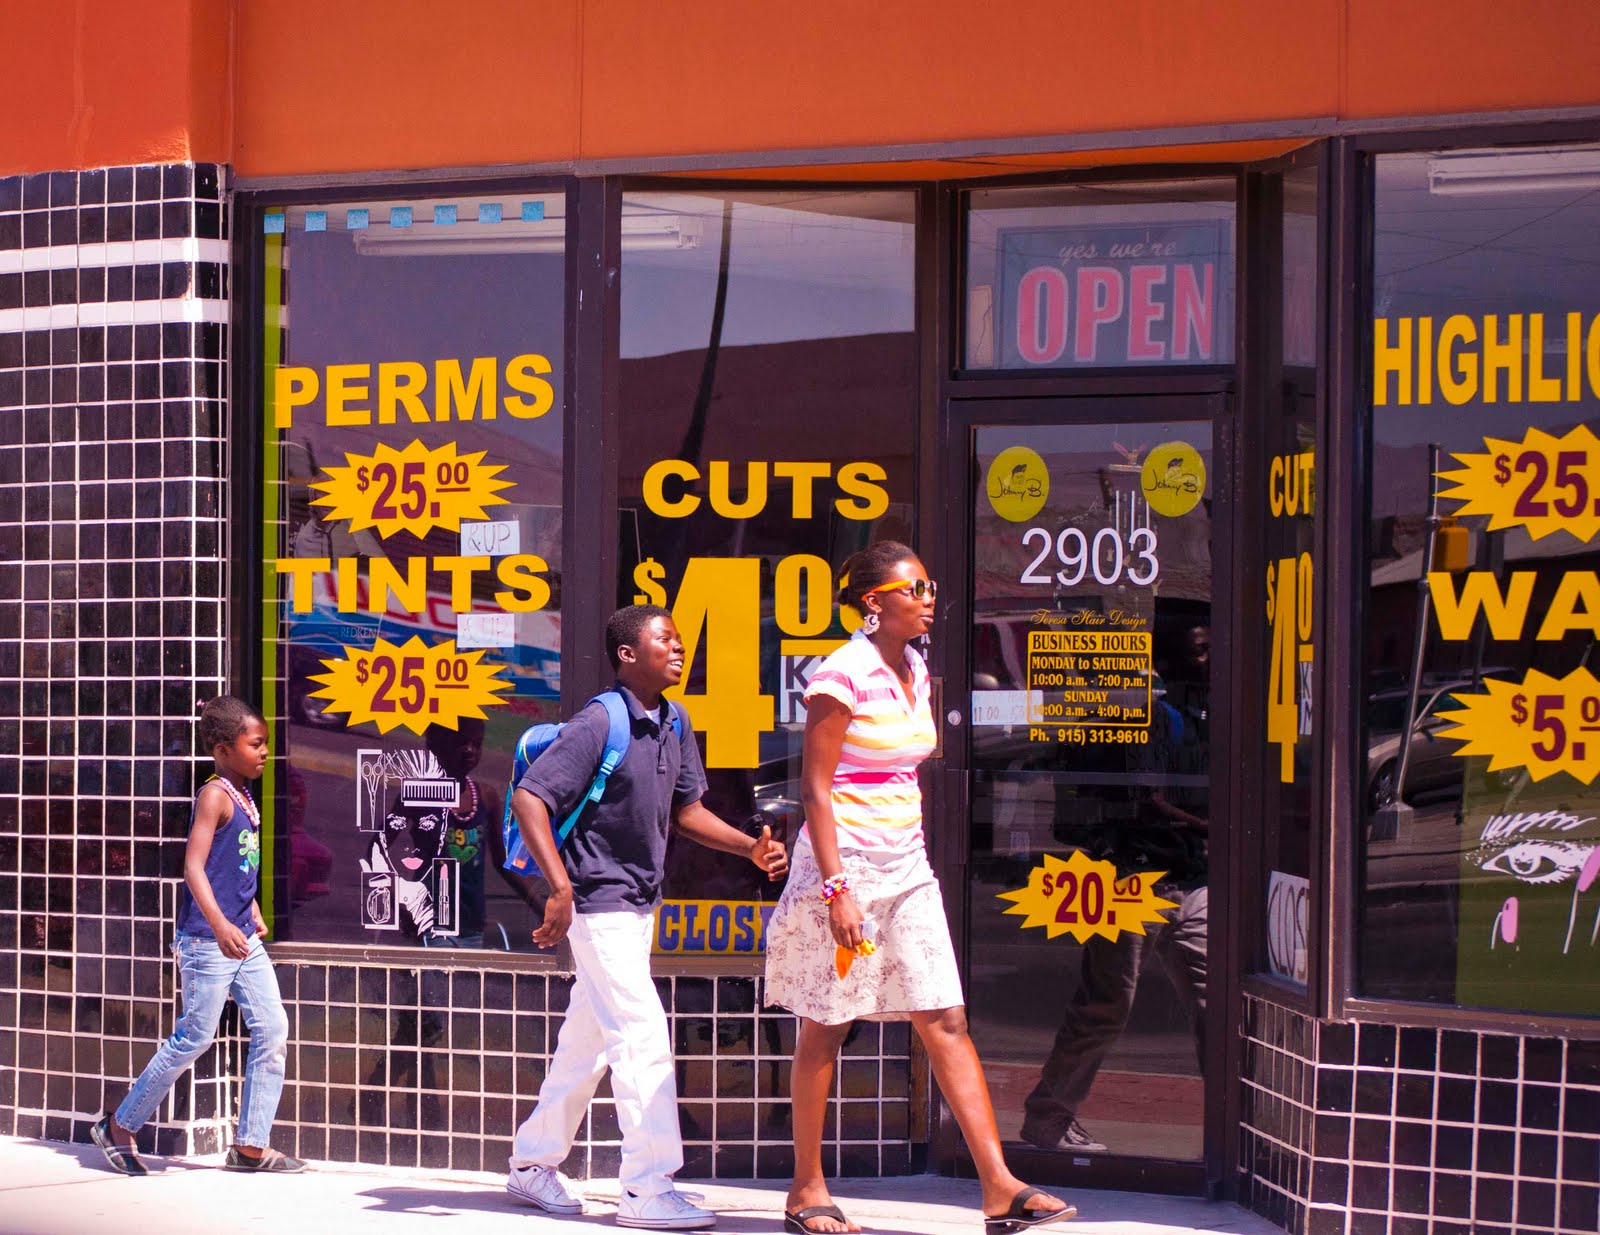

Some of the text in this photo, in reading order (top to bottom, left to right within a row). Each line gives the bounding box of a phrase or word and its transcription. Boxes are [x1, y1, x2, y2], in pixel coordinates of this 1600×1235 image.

[1058, 231, 1177, 265] yes we're
[1017, 263, 1214, 364] OPEN
[274, 354, 554, 428] PERMS
[642, 459, 889, 521] CUTS
[990, 475, 1027, 502] Johnny
[1144, 468, 1182, 496] Johnny
[1269, 452, 1315, 518] CUT
[1020, 527, 1160, 586] 2903
[275, 554, 552, 613] TINTS
[1030, 608, 1147, 630] Teresa Hair Design
[1032, 634, 1147, 651] BUSINESS HOURS
[1031, 656, 1147, 670] MONDAY to SATURDAY
[1032, 673, 1064, 686] 10:00
[1066, 676, 1088, 686] a.m.
[1098, 674, 1121, 687] 7:00
[1123, 676, 1146, 690] p.m.
[1064, 690, 1109, 703] SUNDAY
[1033, 704, 1063, 717] 10:00
[1065, 706, 1088, 717] a.m.
[1097, 704, 1121, 717] 4:00
[1123, 706, 1146, 720] p.m.
[1029, 728, 1149, 746] Ph. 915) 313-9610
